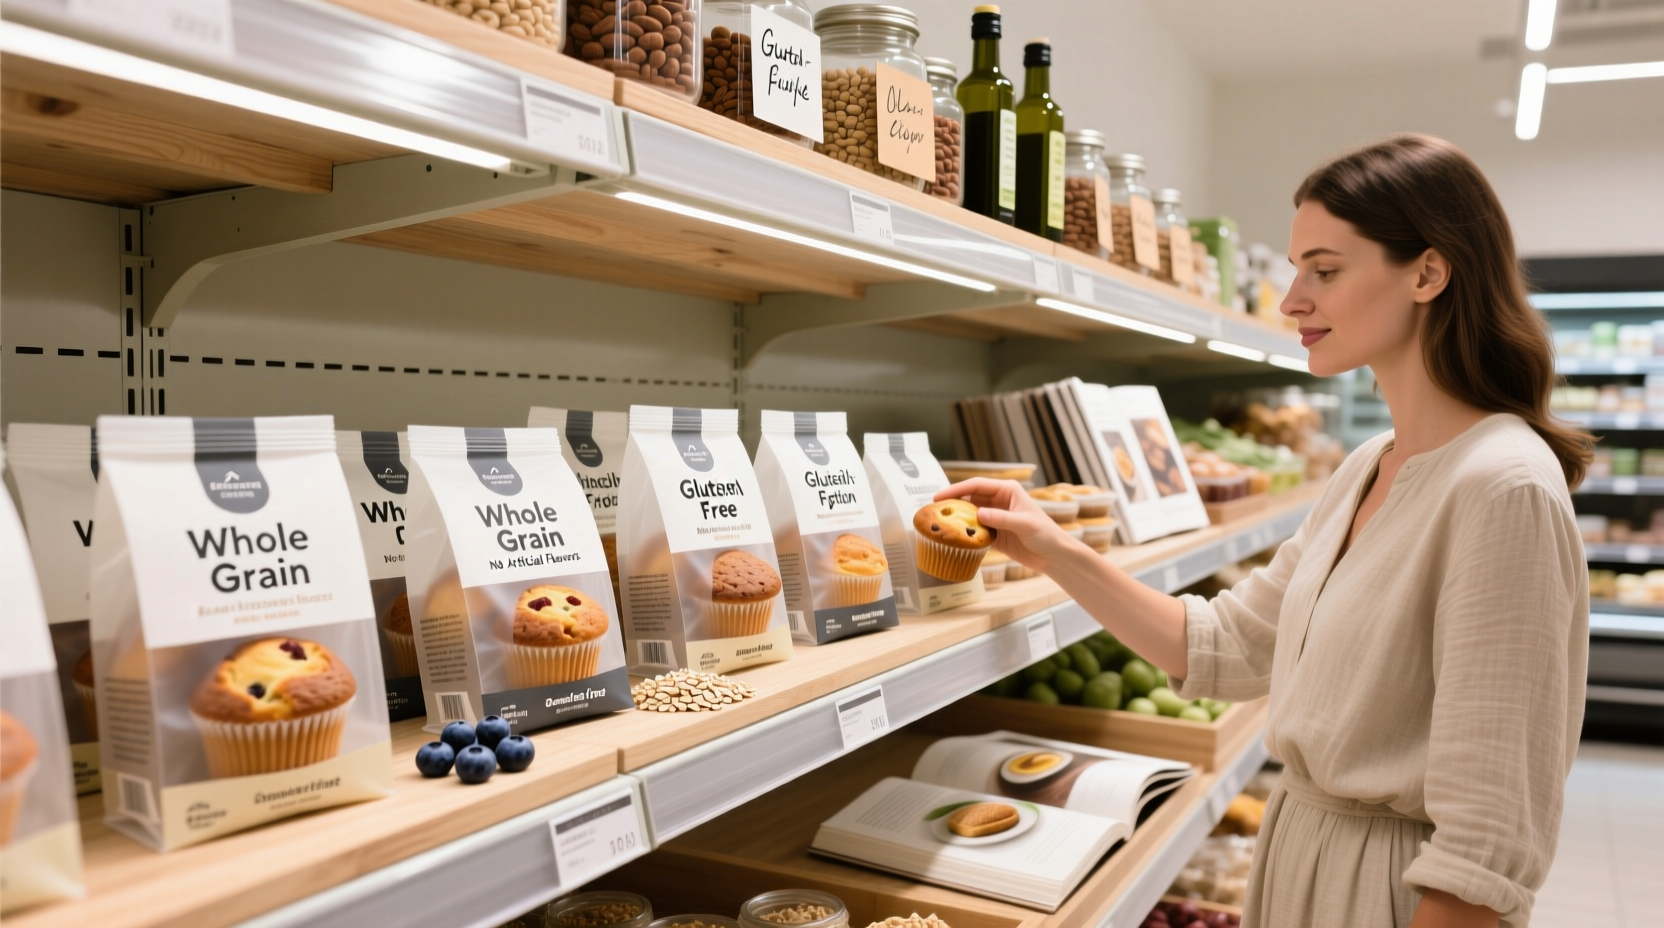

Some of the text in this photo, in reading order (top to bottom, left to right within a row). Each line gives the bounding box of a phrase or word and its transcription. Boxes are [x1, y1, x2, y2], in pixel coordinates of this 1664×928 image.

[360, 500, 407, 523] Wh
[474, 501, 558, 528] Whole
[699, 500, 738, 520] Free
[186, 522, 310, 559] Whole
[496, 527, 565, 552] Grain
[211, 558, 311, 593] Grain
